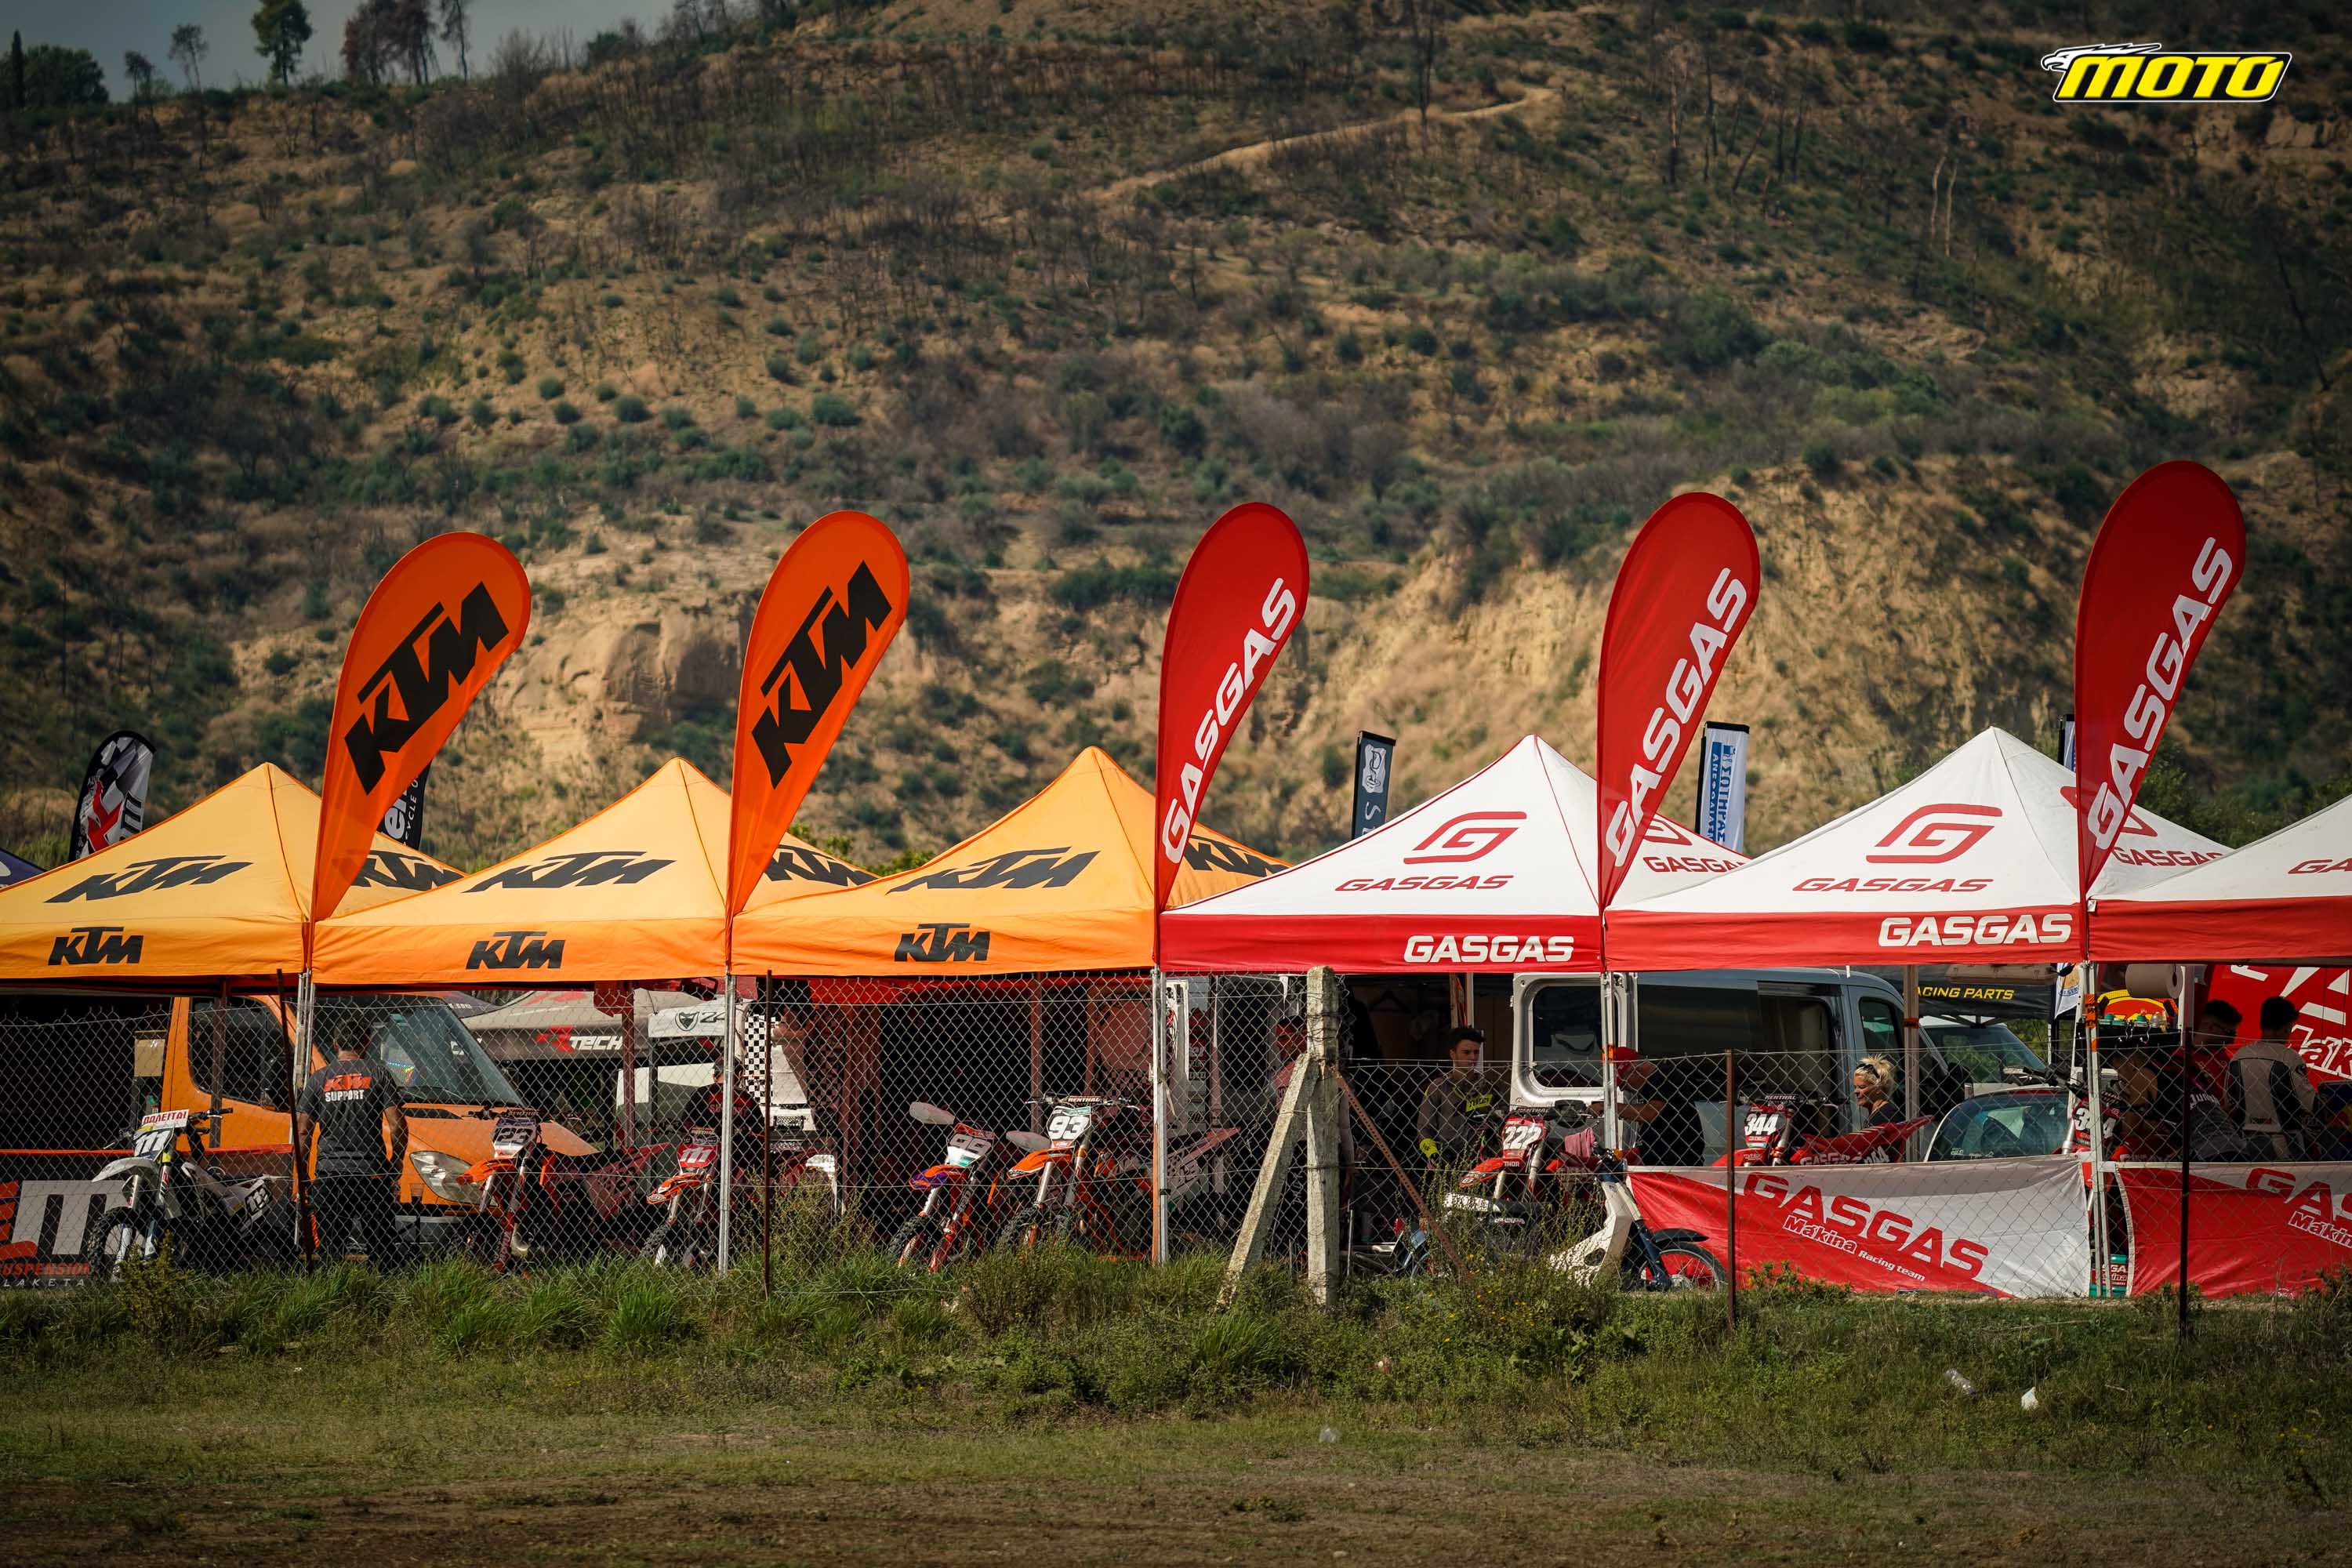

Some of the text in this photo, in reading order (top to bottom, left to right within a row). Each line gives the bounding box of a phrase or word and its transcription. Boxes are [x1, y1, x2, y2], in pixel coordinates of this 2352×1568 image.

[344, 580, 510, 796] KTM
[751, 559, 893, 790] KTM
[2086, 536, 2233, 851] GASGAS
[1162, 577, 1296, 863] GASGAS
[1606, 567, 1747, 867] GASGAS
[43, 855, 253, 903] KTM
[460, 851, 677, 894] KTM
[884, 846, 1101, 896] KTM
[1334, 875, 1515, 892] GASGAS
[1642, 856, 1746, 873] GASGA
[1792, 877, 1994, 892] GASGAS
[48, 926, 143, 966] KTM
[894, 923, 991, 962] KTM
[1403, 935, 1574, 964] GASGAS
[1878, 913, 2074, 947] GASGAS
[466, 931, 565, 970] KTM
[1963, 988, 2015, 1000] PARTS
[323, 1073, 372, 1092] KTM
[325, 1089, 365, 1102] SUPPORT
[1048, 1115, 1090, 1141] 93
[1502, 1126, 1542, 1150] 222
[1744, 1113, 1780, 1136] 344
[679, 1146, 713, 1164] 111
[1744, 1171, 1989, 1281] GASGAS
[1782, 1214, 1926, 1283] Makina Racing team
